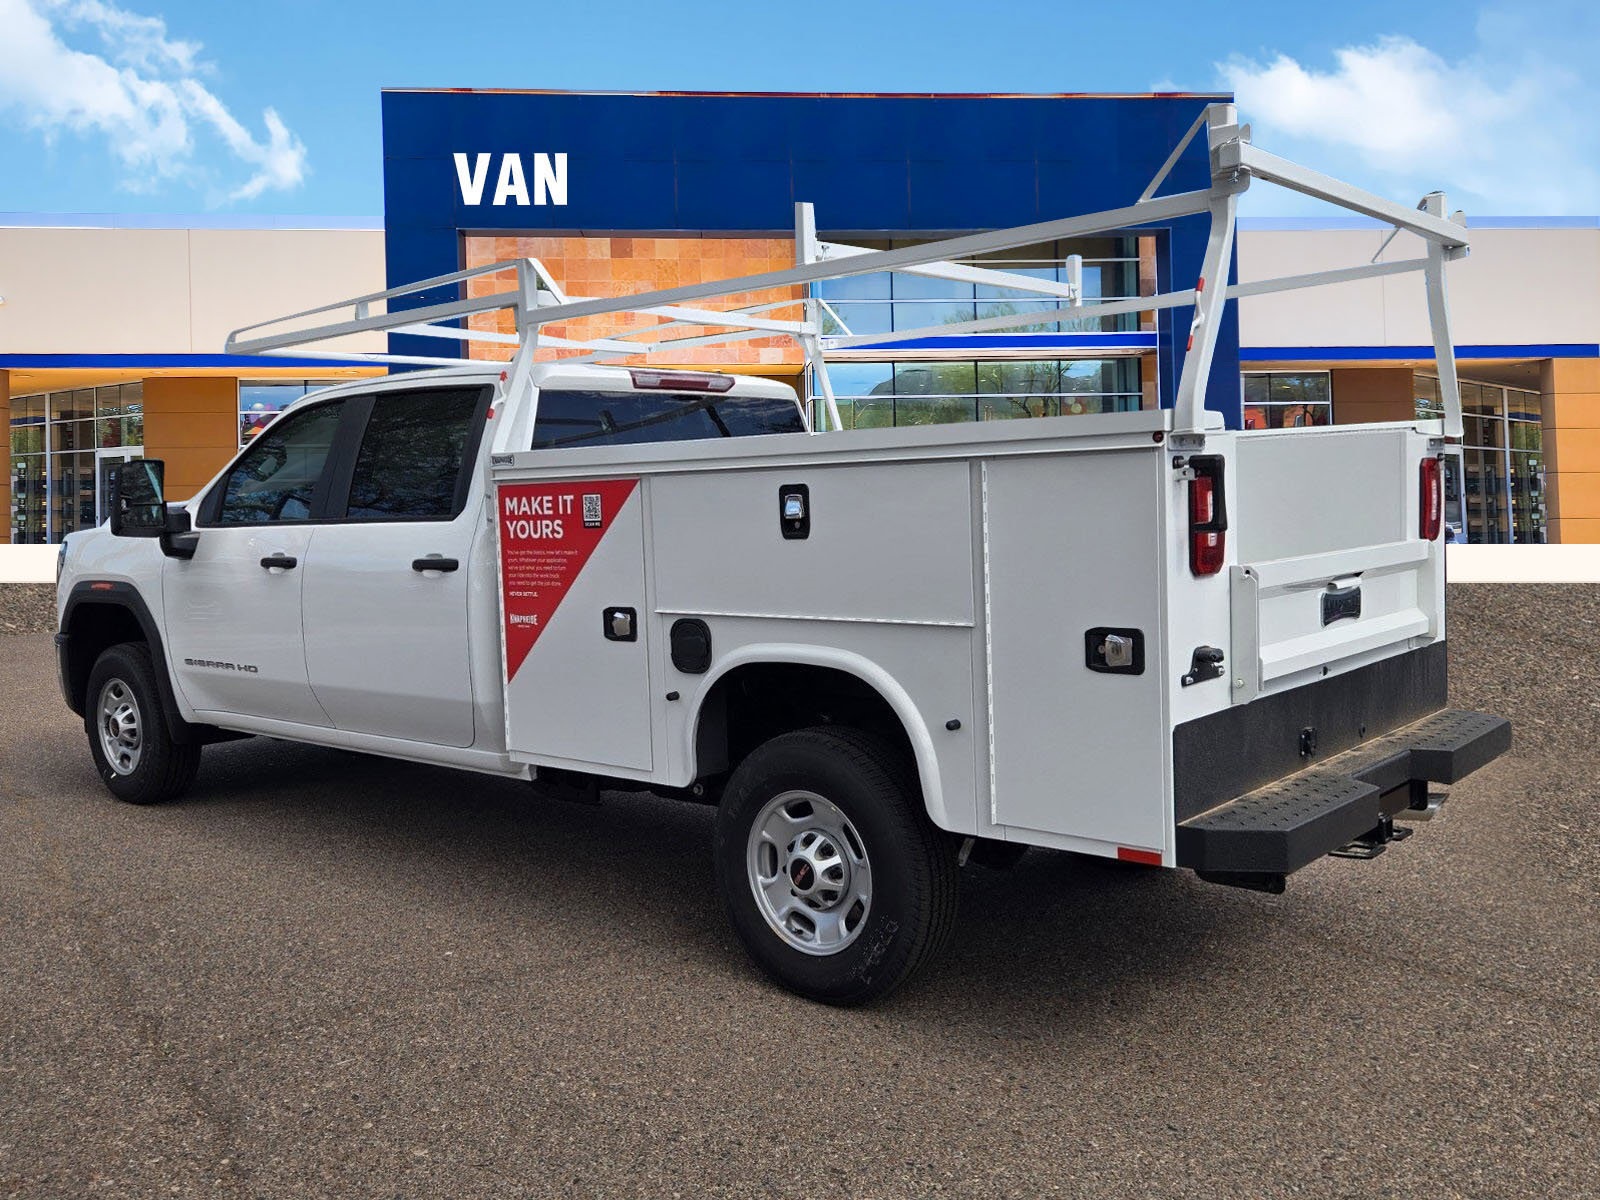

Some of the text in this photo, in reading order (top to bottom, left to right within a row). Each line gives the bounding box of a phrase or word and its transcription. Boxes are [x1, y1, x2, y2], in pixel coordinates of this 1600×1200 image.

[453, 152, 568, 205] VAN
[505, 495, 574, 516] MAKE IT
[506, 519, 564, 539] YOURS
[184, 658, 258, 673] SIERRA HD
